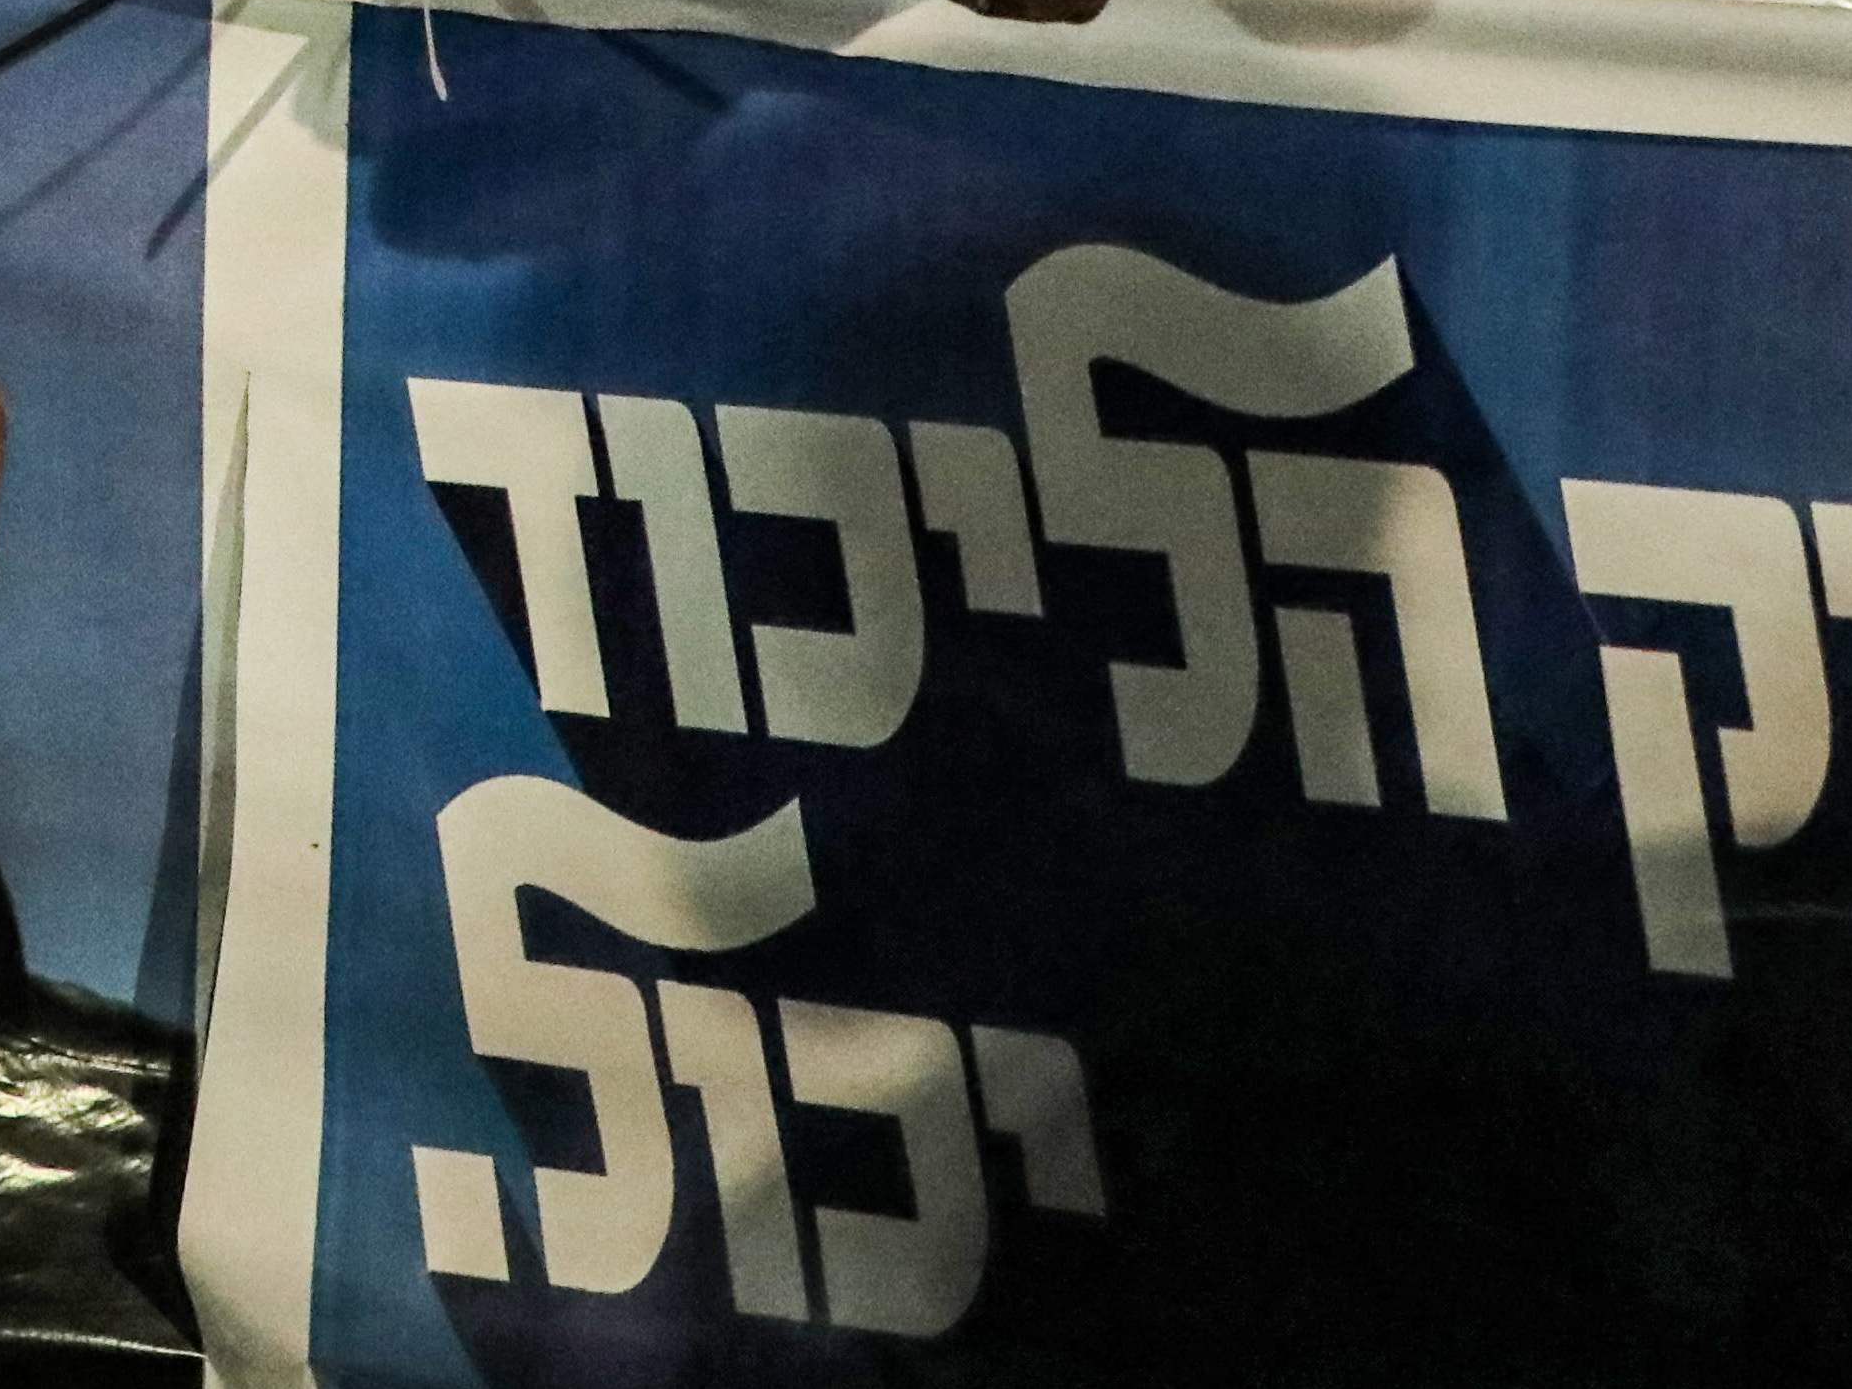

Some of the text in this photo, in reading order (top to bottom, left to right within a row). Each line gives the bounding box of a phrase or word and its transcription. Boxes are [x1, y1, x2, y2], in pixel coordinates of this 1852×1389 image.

[406, 243, 1852, 981] ק הליכוד
[412, 774, 1107, 1339] יכול.
